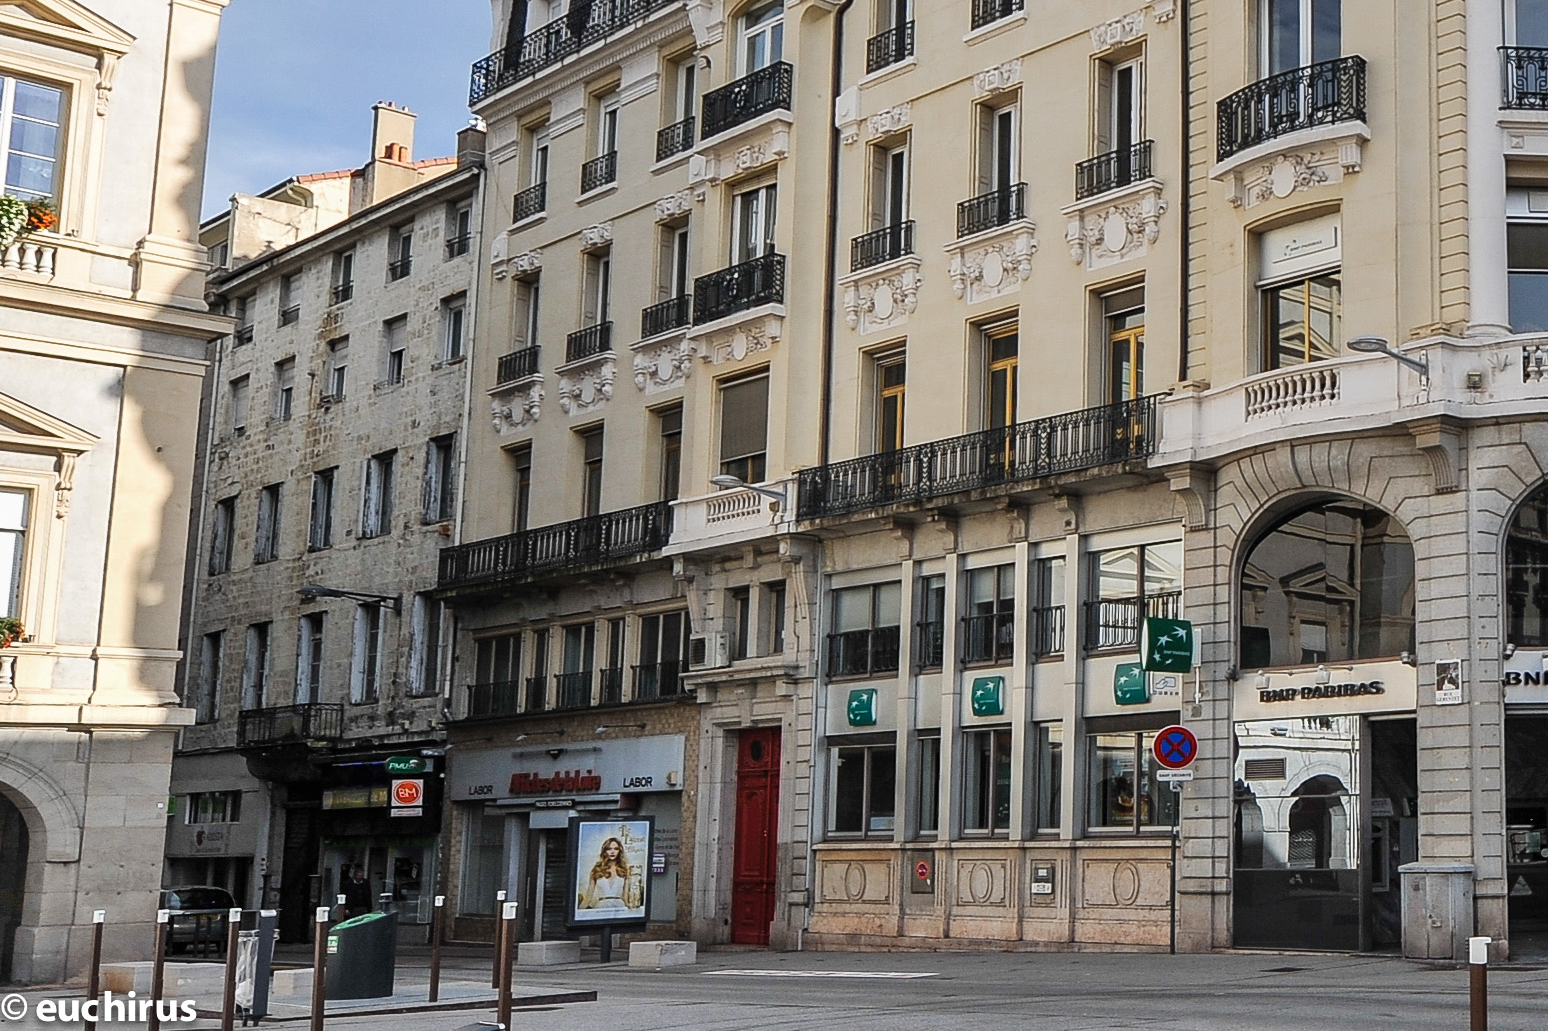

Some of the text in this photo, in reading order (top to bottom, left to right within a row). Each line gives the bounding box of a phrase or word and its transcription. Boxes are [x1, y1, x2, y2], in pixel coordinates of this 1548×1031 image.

[1259, 681, 1385, 703] BNP PARIBAS
[388, 761, 409, 770] PMU
[623, 777, 653, 788] LABOR
[398, 788, 417, 798] BM
[469, 785, 493, 796] LABOR
